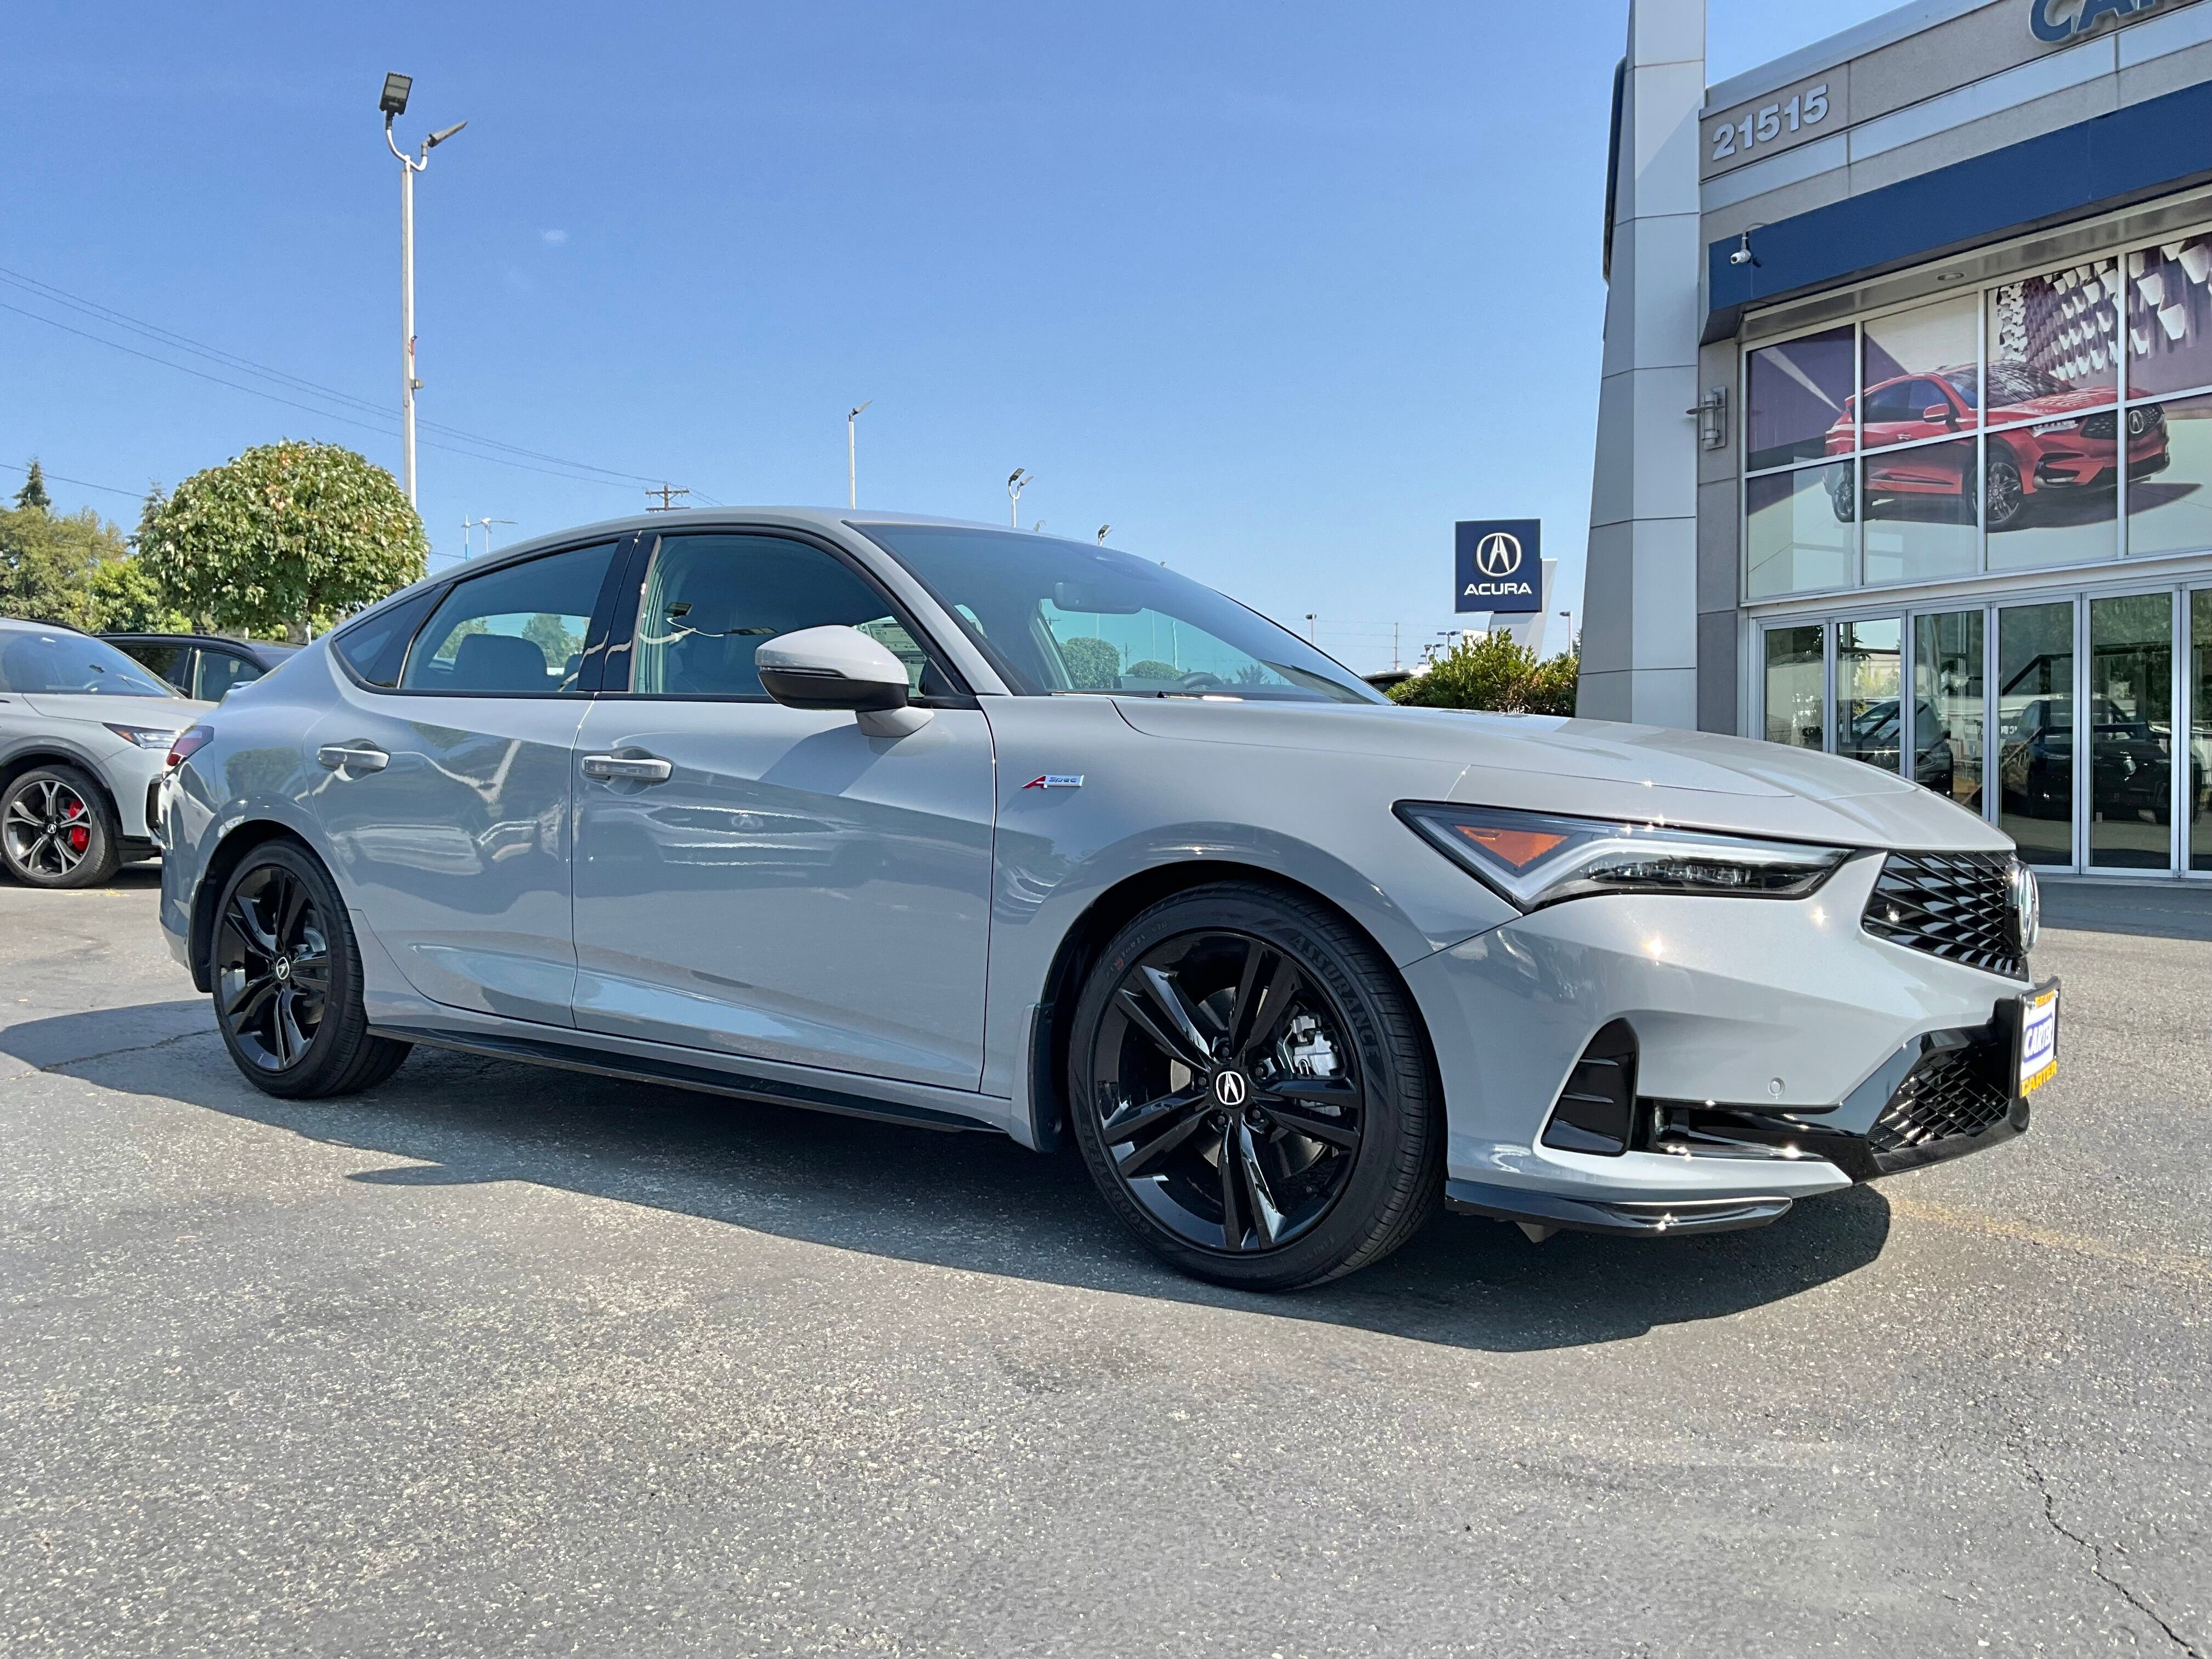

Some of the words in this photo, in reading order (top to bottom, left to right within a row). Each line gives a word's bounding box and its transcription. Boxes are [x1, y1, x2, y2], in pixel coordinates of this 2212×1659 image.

[2029, 0, 2156, 42] CA
[1712, 83, 1829, 161] 21515
[1464, 583, 1532, 596] ACURA
[1292, 934, 1383, 1059] ASSURANCE
[2024, 1018, 2053, 1058] CARTER
[2021, 1060, 2057, 1097] CARTER
